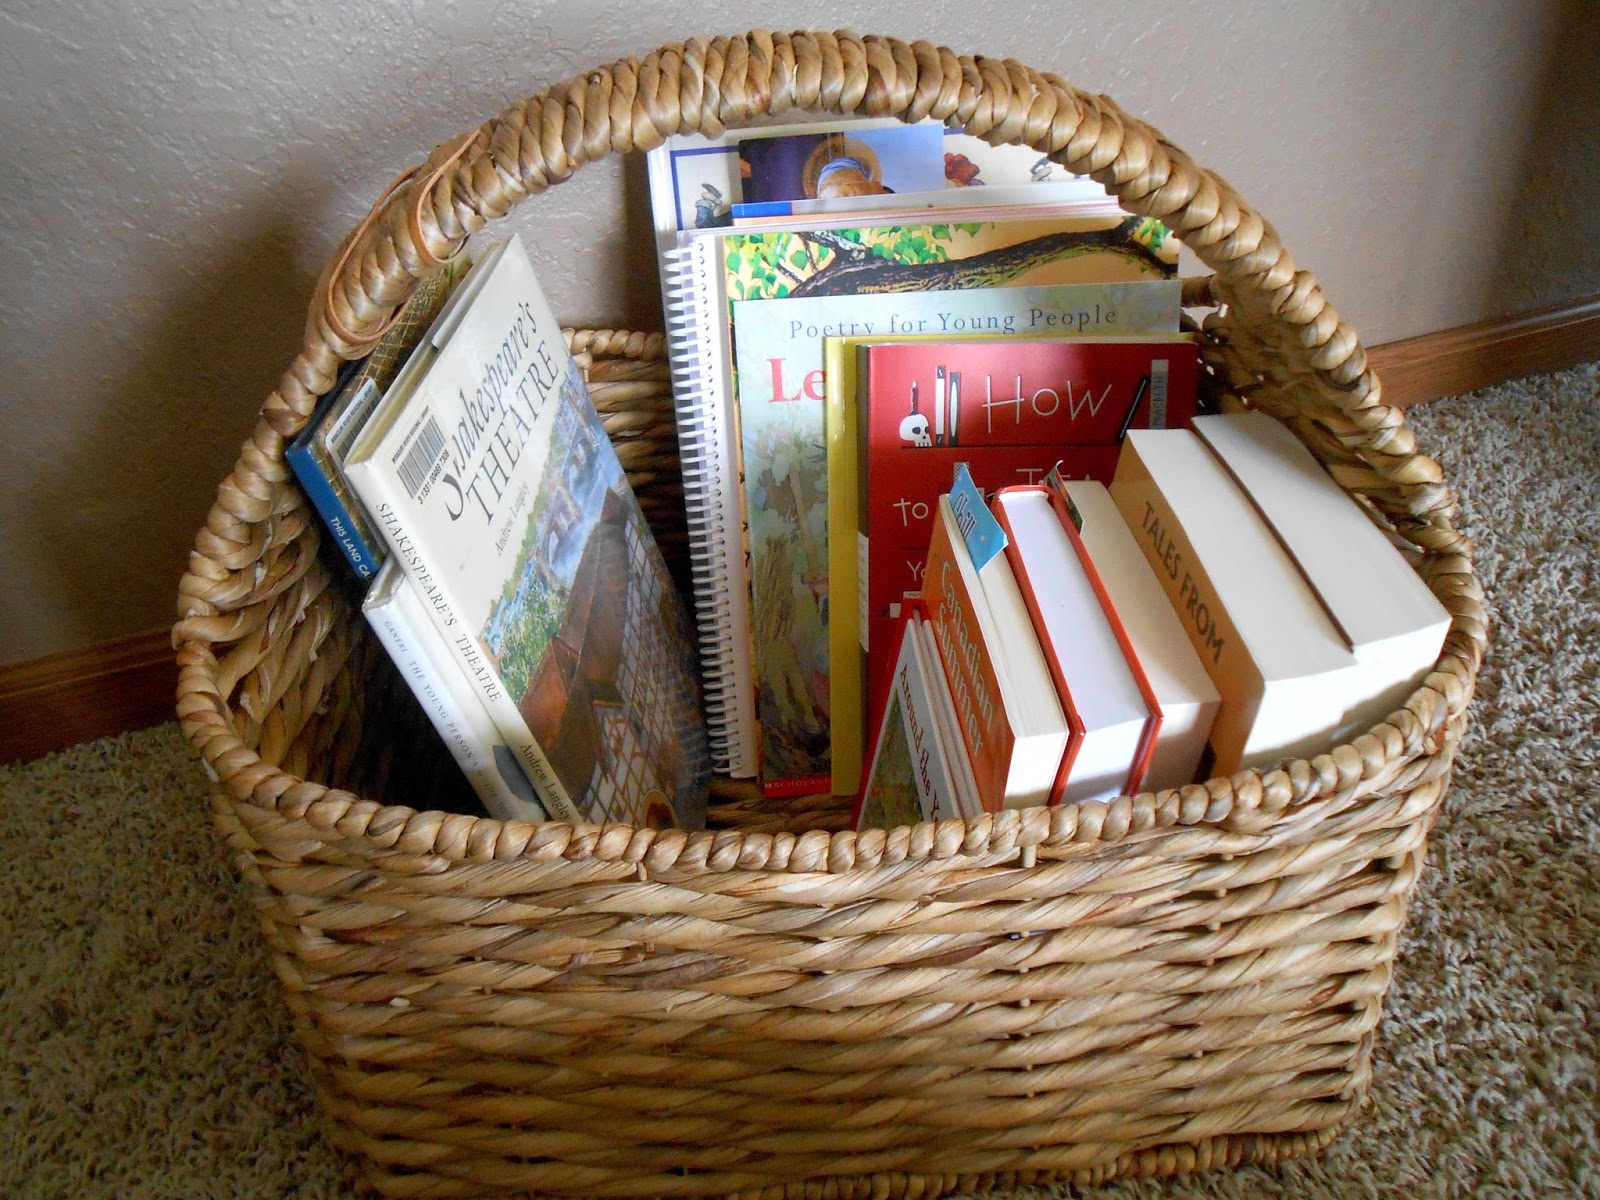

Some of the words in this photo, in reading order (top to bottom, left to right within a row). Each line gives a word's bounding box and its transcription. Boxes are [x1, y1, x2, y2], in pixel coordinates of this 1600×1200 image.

[766, 357, 826, 403] Le
[789, 320, 874, 338] Poetry
[890, 314, 927, 332] for
[938, 313, 1015, 334] Young
[1030, 305, 1116, 331] People
[466, 340, 559, 525] THEATRE
[331, 517, 347, 537] THIS
[343, 538, 362, 563] LAND
[359, 564, 371, 578] CA
[1141, 501, 1181, 580] TALES
[1179, 573, 1225, 663] FROM
[376, 502, 457, 627] SHAKESPEARE'S
[454, 634, 502, 703] THEATRE
[520, 744, 547, 781] Andrew
[545, 783, 572, 820] Langley
[408, 660, 426, 681] THE
[423, 684, 449, 720] YOUNG
[936, 602, 984, 758] Summer
[942, 561, 993, 732] Canadian
[774, 778, 829, 788] SCHOLAST
[900, 664, 924, 754] Around
[919, 748, 931, 797] the
